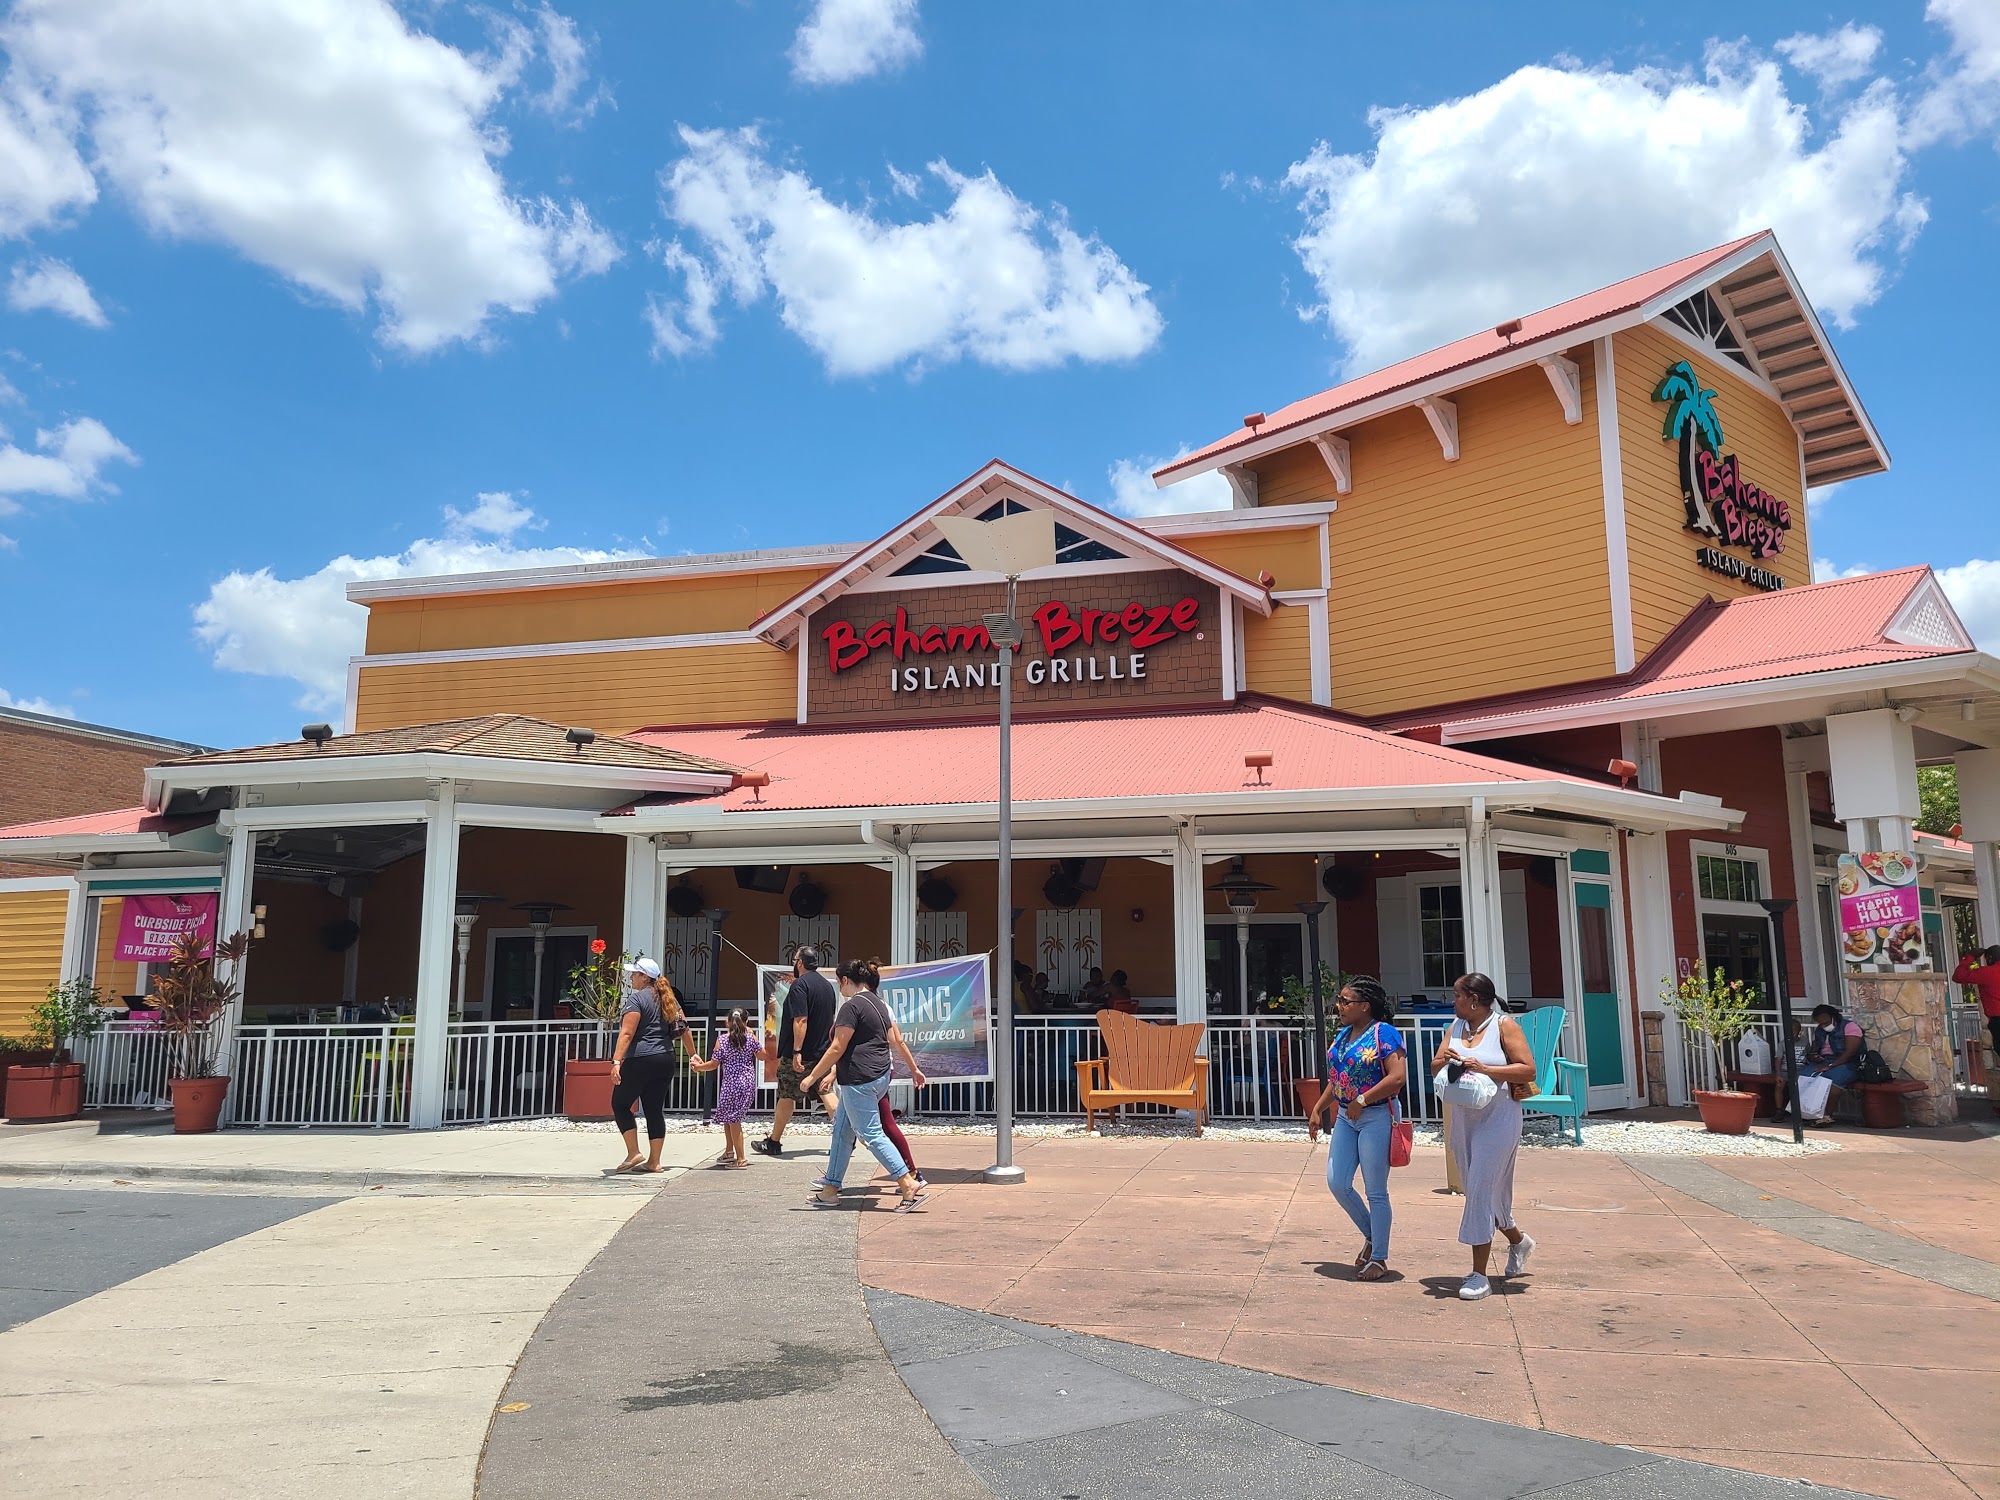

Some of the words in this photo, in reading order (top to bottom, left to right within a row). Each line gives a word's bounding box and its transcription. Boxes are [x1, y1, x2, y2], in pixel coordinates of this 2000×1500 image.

[1699, 450, 1791, 529] Bahama
[1721, 498, 1785, 559] Breeze
[1706, 548, 1746, 577] ISLAND
[822, 606, 1022, 673] Baham
[1032, 598, 1199, 657] Breeze
[1026, 653, 1146, 685] GRILLE
[1725, 843, 1737, 856] 805
[1856, 895, 1900, 912] HAPPY
[1858, 905, 1904, 924] HOUR
[135, 915, 186, 931] CURBSIDE
[124, 944, 134, 955] TO
[134, 945, 157, 956] PLACE
[883, 986, 951, 1023] IRING
[902, 1027, 966, 1046] m/careers
